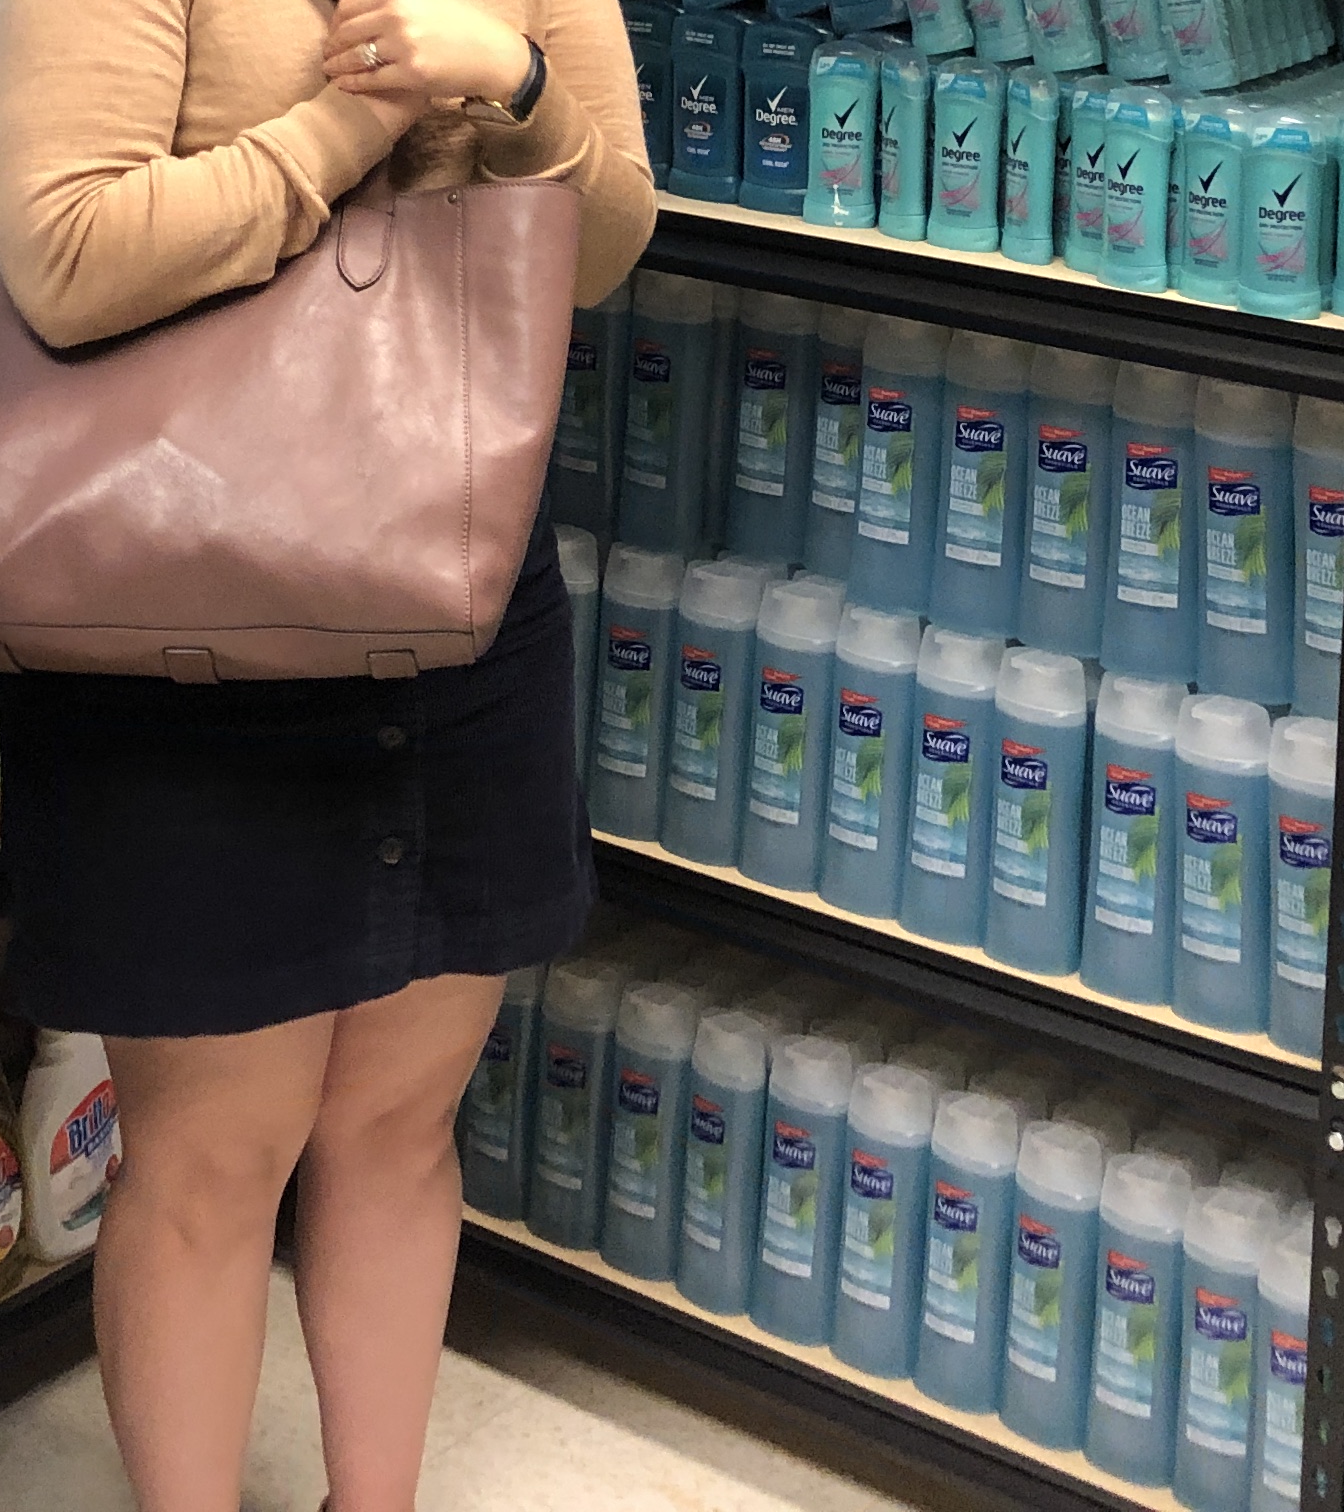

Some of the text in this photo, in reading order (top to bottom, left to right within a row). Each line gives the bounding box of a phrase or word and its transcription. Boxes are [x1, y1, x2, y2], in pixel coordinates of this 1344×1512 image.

[681, 96, 719, 115] Degree
[756, 108, 798, 126] Degree
[822, 127, 863, 141] Degree
[941, 146, 981, 162] Degree
[1076, 167, 1105, 183] Degre
[1107, 178, 1144, 196] Degree
[1188, 190, 1228, 209] Degree
[1258, 206, 1307, 223] Degree
[569, 348, 594, 364] uave
[745, 361, 784, 384] Suave
[823, 377, 860, 398] Suave
[868, 402, 911, 425] Suave
[958, 422, 1002, 444] Suave
[1040, 442, 1085, 464] Suave
[1127, 460, 1175, 482] Suave
[1210, 484, 1258, 507] Suave
[1121, 503, 1151, 522] OCEAN
[1207, 528, 1235, 547] OCEAN
[610, 642, 649, 665] Suave
[683, 662, 719, 684] Suave
[763, 684, 801, 707] Suave
[842, 705, 880, 730] Suave
[925, 731, 967, 755] Suave
[1004, 758, 1044, 782] Suave
[1108, 783, 1154, 808] Suave
[1190, 810, 1235, 837] Suave
[1282, 834, 1329, 862] Suave
[67, 1086, 112, 1157] Brillo
